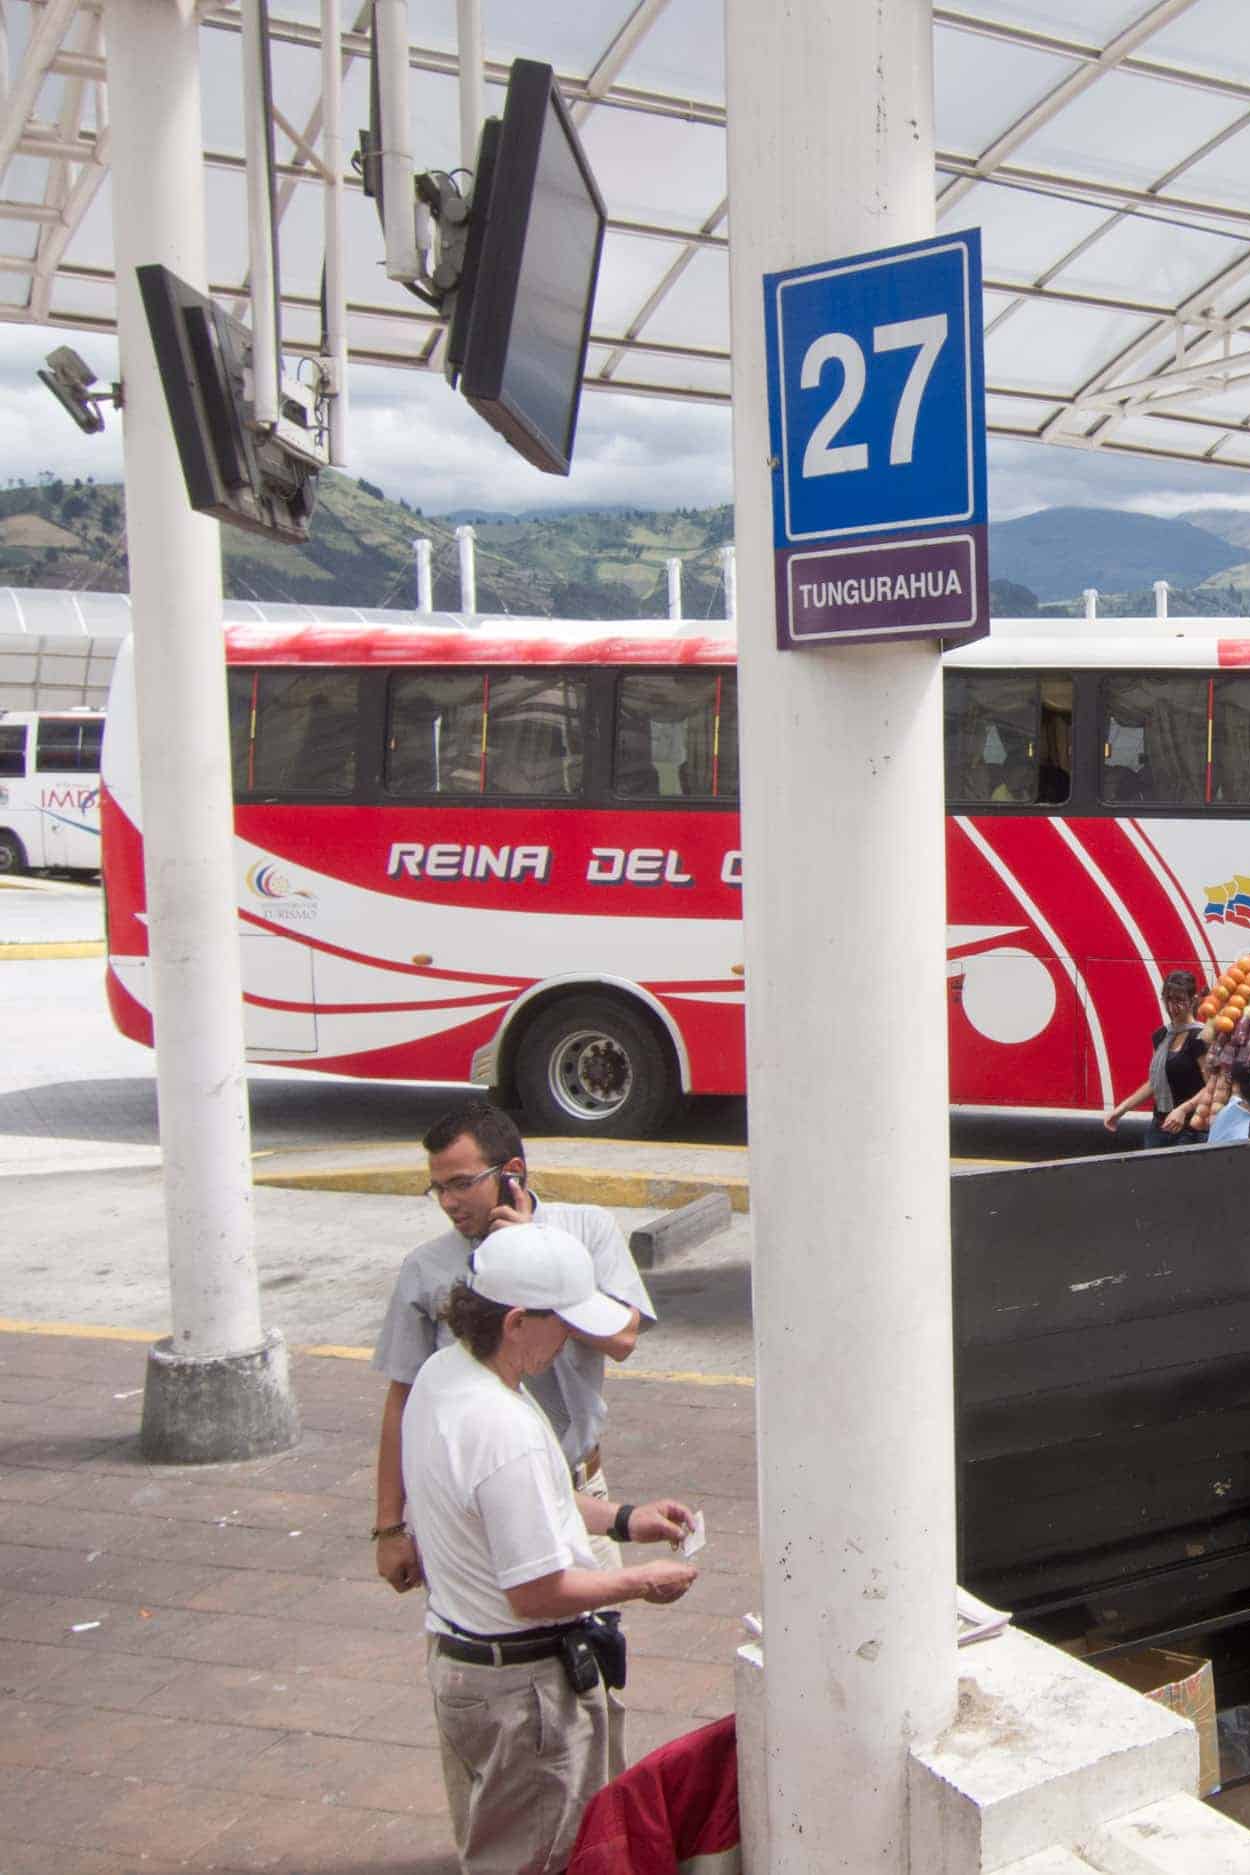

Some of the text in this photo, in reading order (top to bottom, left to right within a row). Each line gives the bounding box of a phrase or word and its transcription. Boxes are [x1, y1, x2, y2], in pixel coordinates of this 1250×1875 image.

[800, 313, 948, 478] 27
[800, 569, 963, 609] TUNGURAHUA
[387, 843, 551, 880] REINA
[586, 847, 693, 884] DEL
